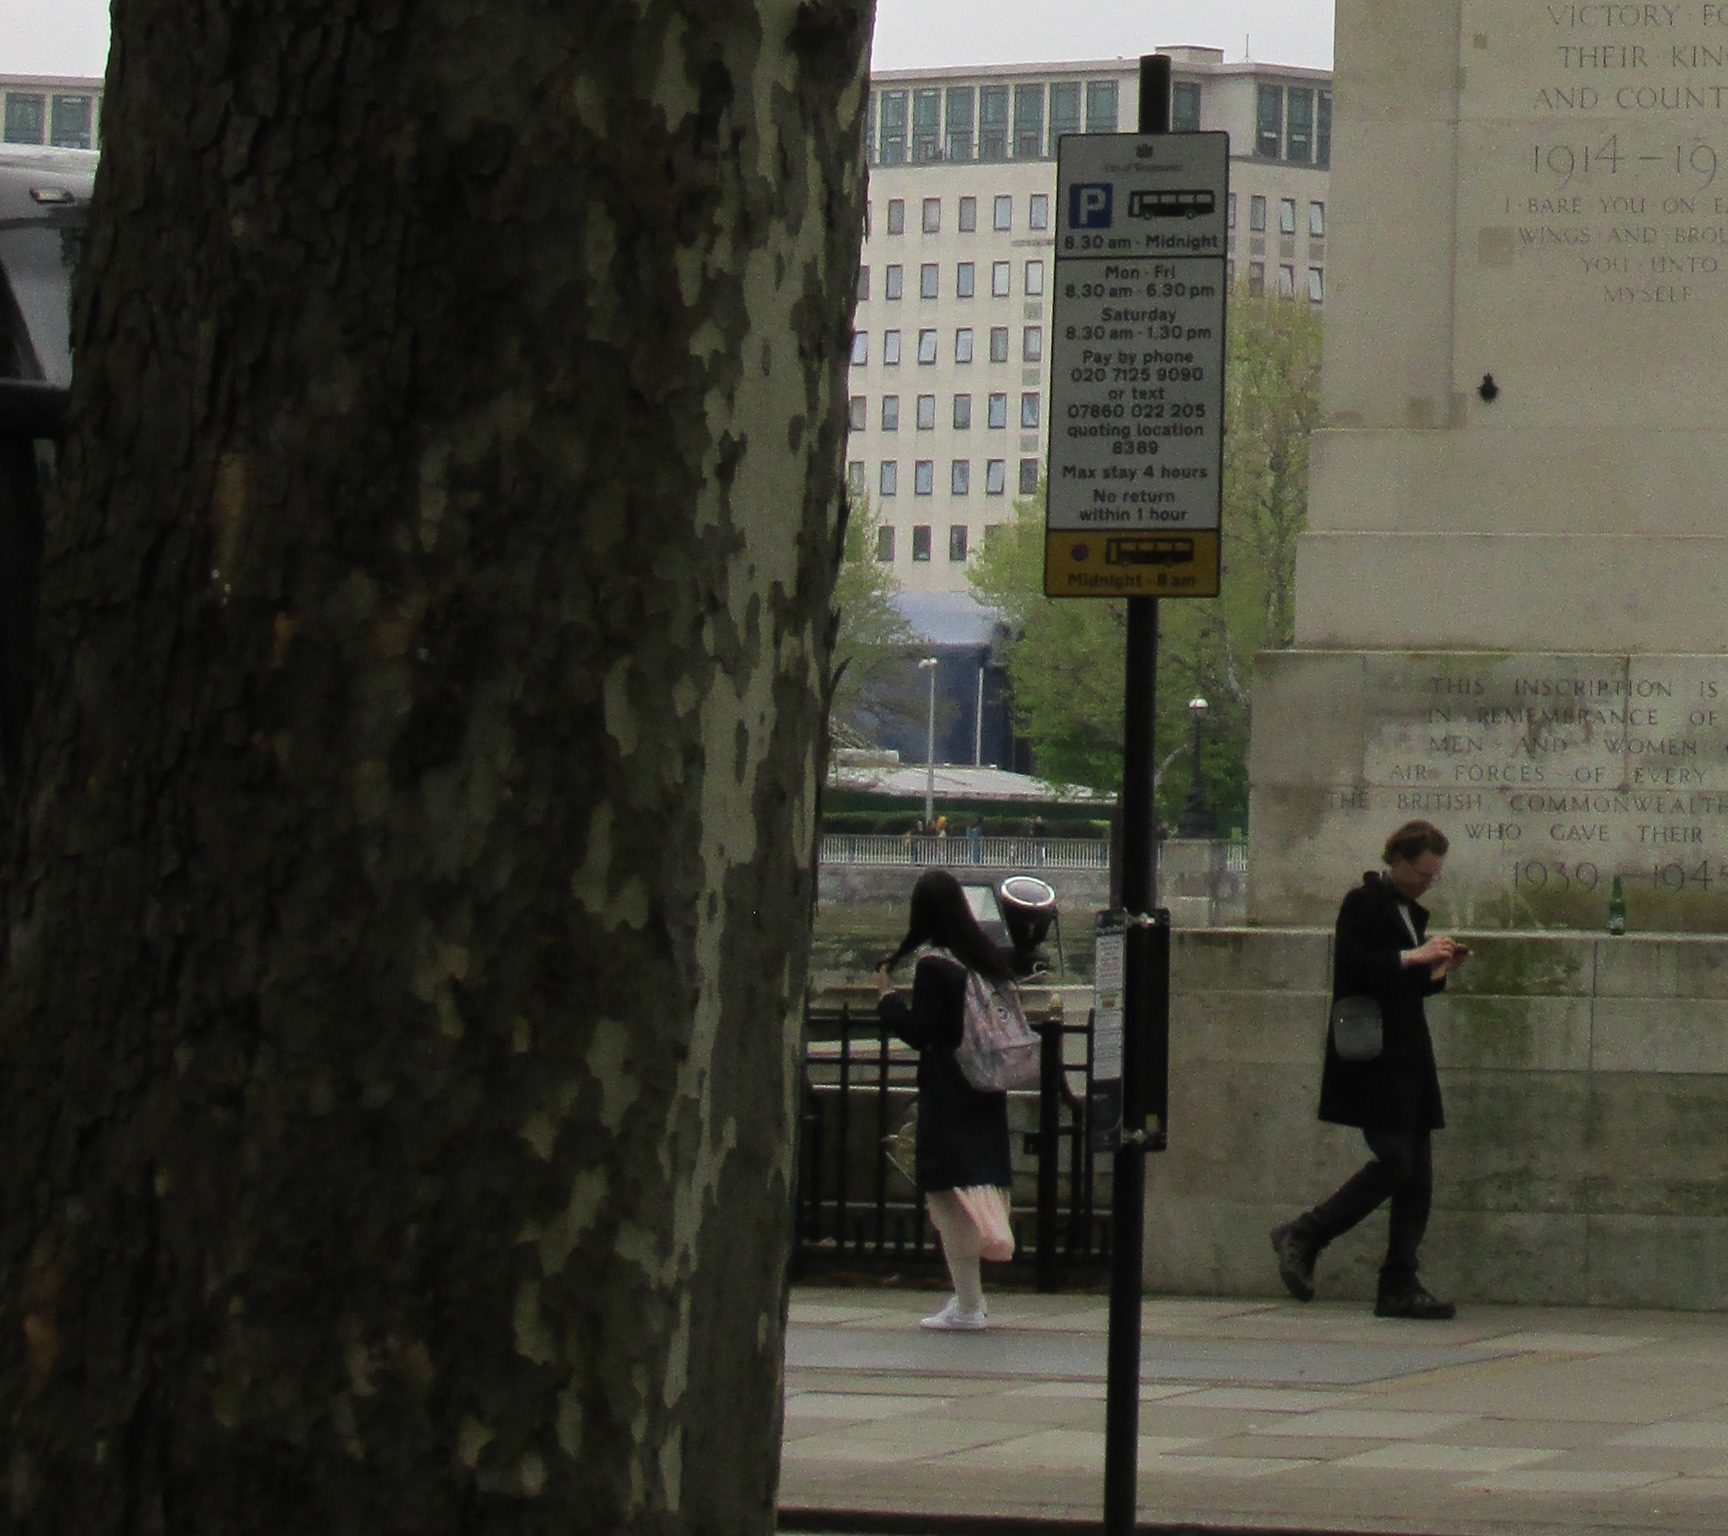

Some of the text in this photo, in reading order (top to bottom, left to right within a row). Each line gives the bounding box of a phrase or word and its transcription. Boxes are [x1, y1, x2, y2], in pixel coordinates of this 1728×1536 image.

[1547, 4, 1681, 28] VICTORY
[1557, 46, 1648, 69] THEIR
[1533, 87, 1599, 110] AND
[1080, 188, 1106, 225] P
[1504, 196, 1511, 214] I
[1528, 197, 1582, 214] BARE
[1599, 197, 1646, 214] YOU
[1662, 197, 1695, 214] ON
[1065, 234, 1218, 251] 8.30 am Midnight
[1518, 227, 1590, 245] WINGS
[1607, 227, 1658, 244] AND
[1106, 264, 1175, 279] Mon Fri
[1582, 257, 1719, 273] YOU UNTO
[1065, 282, 1214, 299] 8.30 am 6.30 pm
[1100, 307, 1177, 324] Saturday
[1066, 325, 1212, 342] 8.30 am 1.30 pm
[1082, 349, 1194, 366] Pay by phone
[1071, 367, 1203, 382] 020 7125 9090
[1108, 387, 1165, 400] or text
[1067, 403, 1205, 418] 07860 022 205
[1067, 423, 1204, 439] quoting location
[1062, 465, 1208, 482] Max stay 4 hours
[1093, 488, 1175, 503] No return
[1080, 507, 1130, 521] within
[1150, 507, 1187, 521] hour
[1068, 573, 1142, 589] Midnight
[1171, 576, 1195, 587] am
[1431, 677, 1485, 695] THIS
[1514, 678, 1672, 697] INSCRIPTION
[1699, 681, 1719, 698] IS
[1427, 708, 1451, 724] IN
[1478, 708, 1659, 726] REMEMBRANCE
[1689, 710, 1719, 727] OF
[1429, 735, 1482, 753] MEN
[1513, 736, 1568, 755] AND
[1603, 736, 1698, 756] WOMEN
[1391, 764, 1428, 781] AIR
[1455, 764, 1545, 783] FORCES
[1575, 766, 1605, 783] OF
[1635, 767, 1708, 786] EVERY
[1327, 791, 1369, 810] THE
[1397, 792, 1482, 810] BRITISH
[1465, 822, 1521, 841] WHO
[1550, 823, 1610, 842] GAVE
[1637, 825, 1703, 844] THEIR
